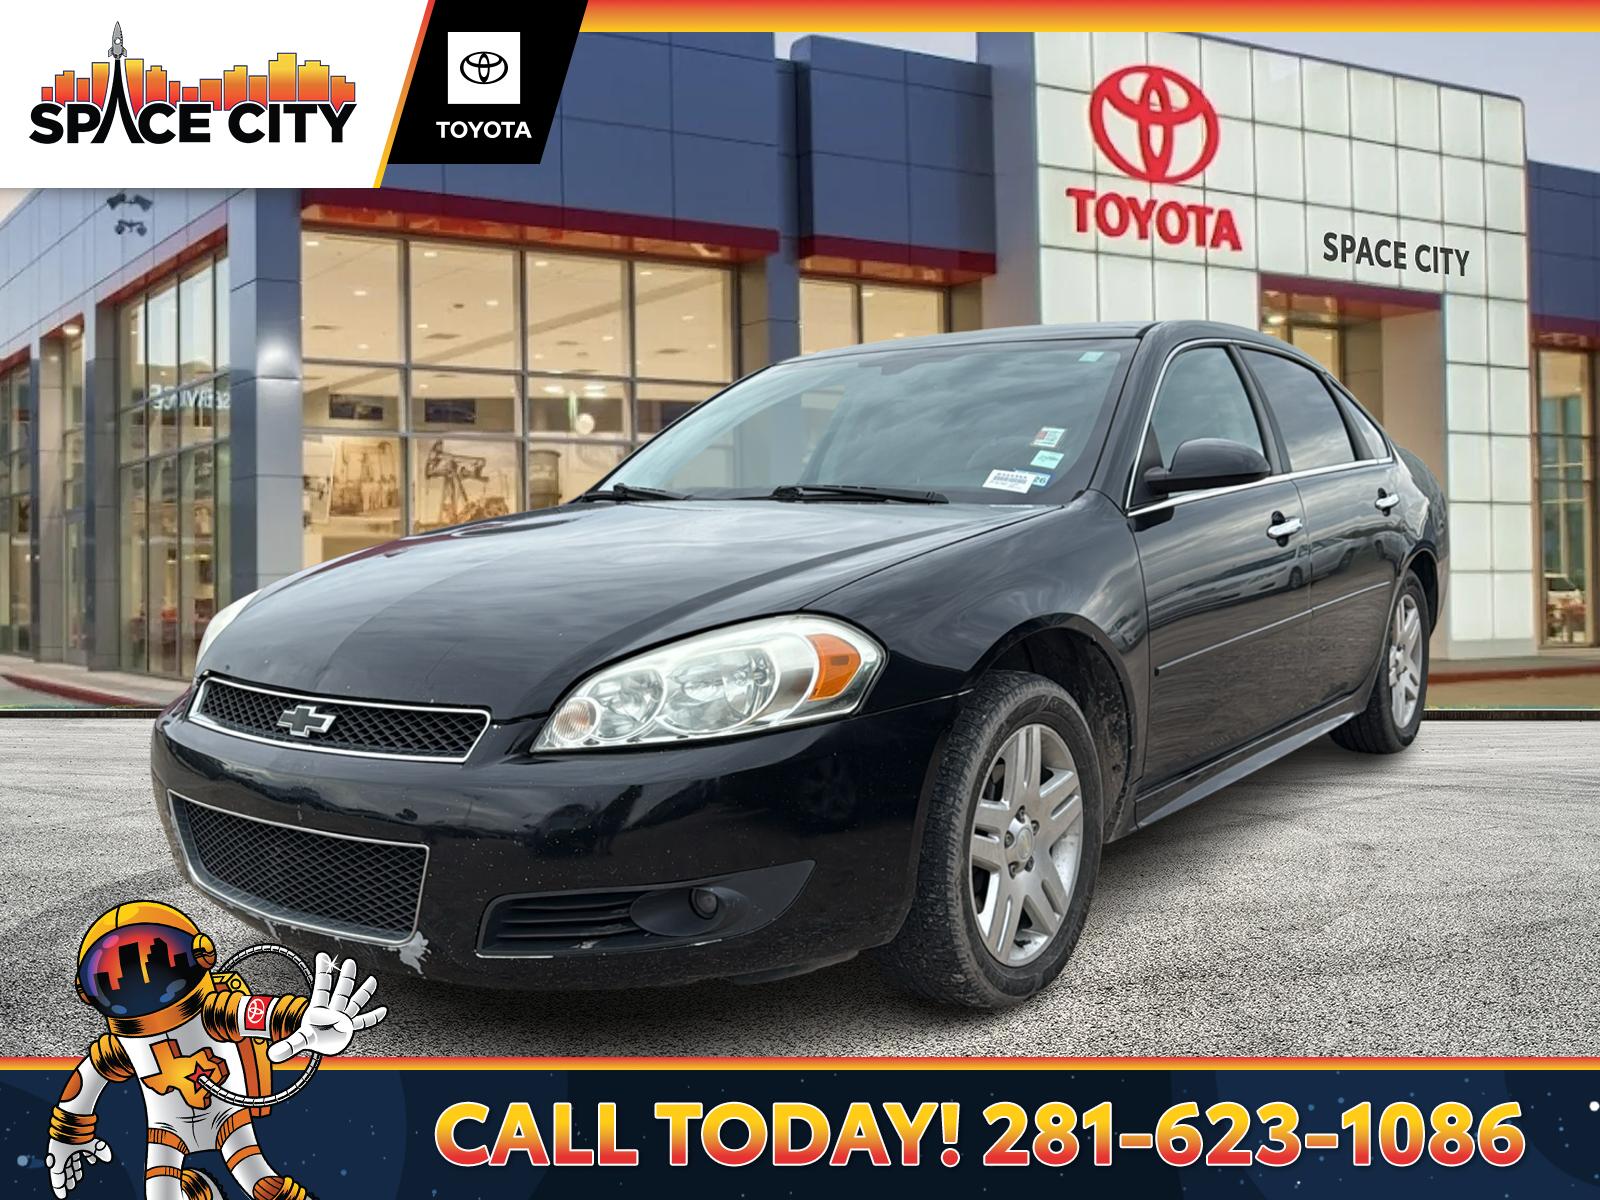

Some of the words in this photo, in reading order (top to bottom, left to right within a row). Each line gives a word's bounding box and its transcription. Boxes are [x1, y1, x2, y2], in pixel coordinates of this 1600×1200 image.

[1065, 187, 1243, 251] TOYOTA
[1323, 232, 1407, 270] SPACE
[1415, 244, 1470, 277] CITY
